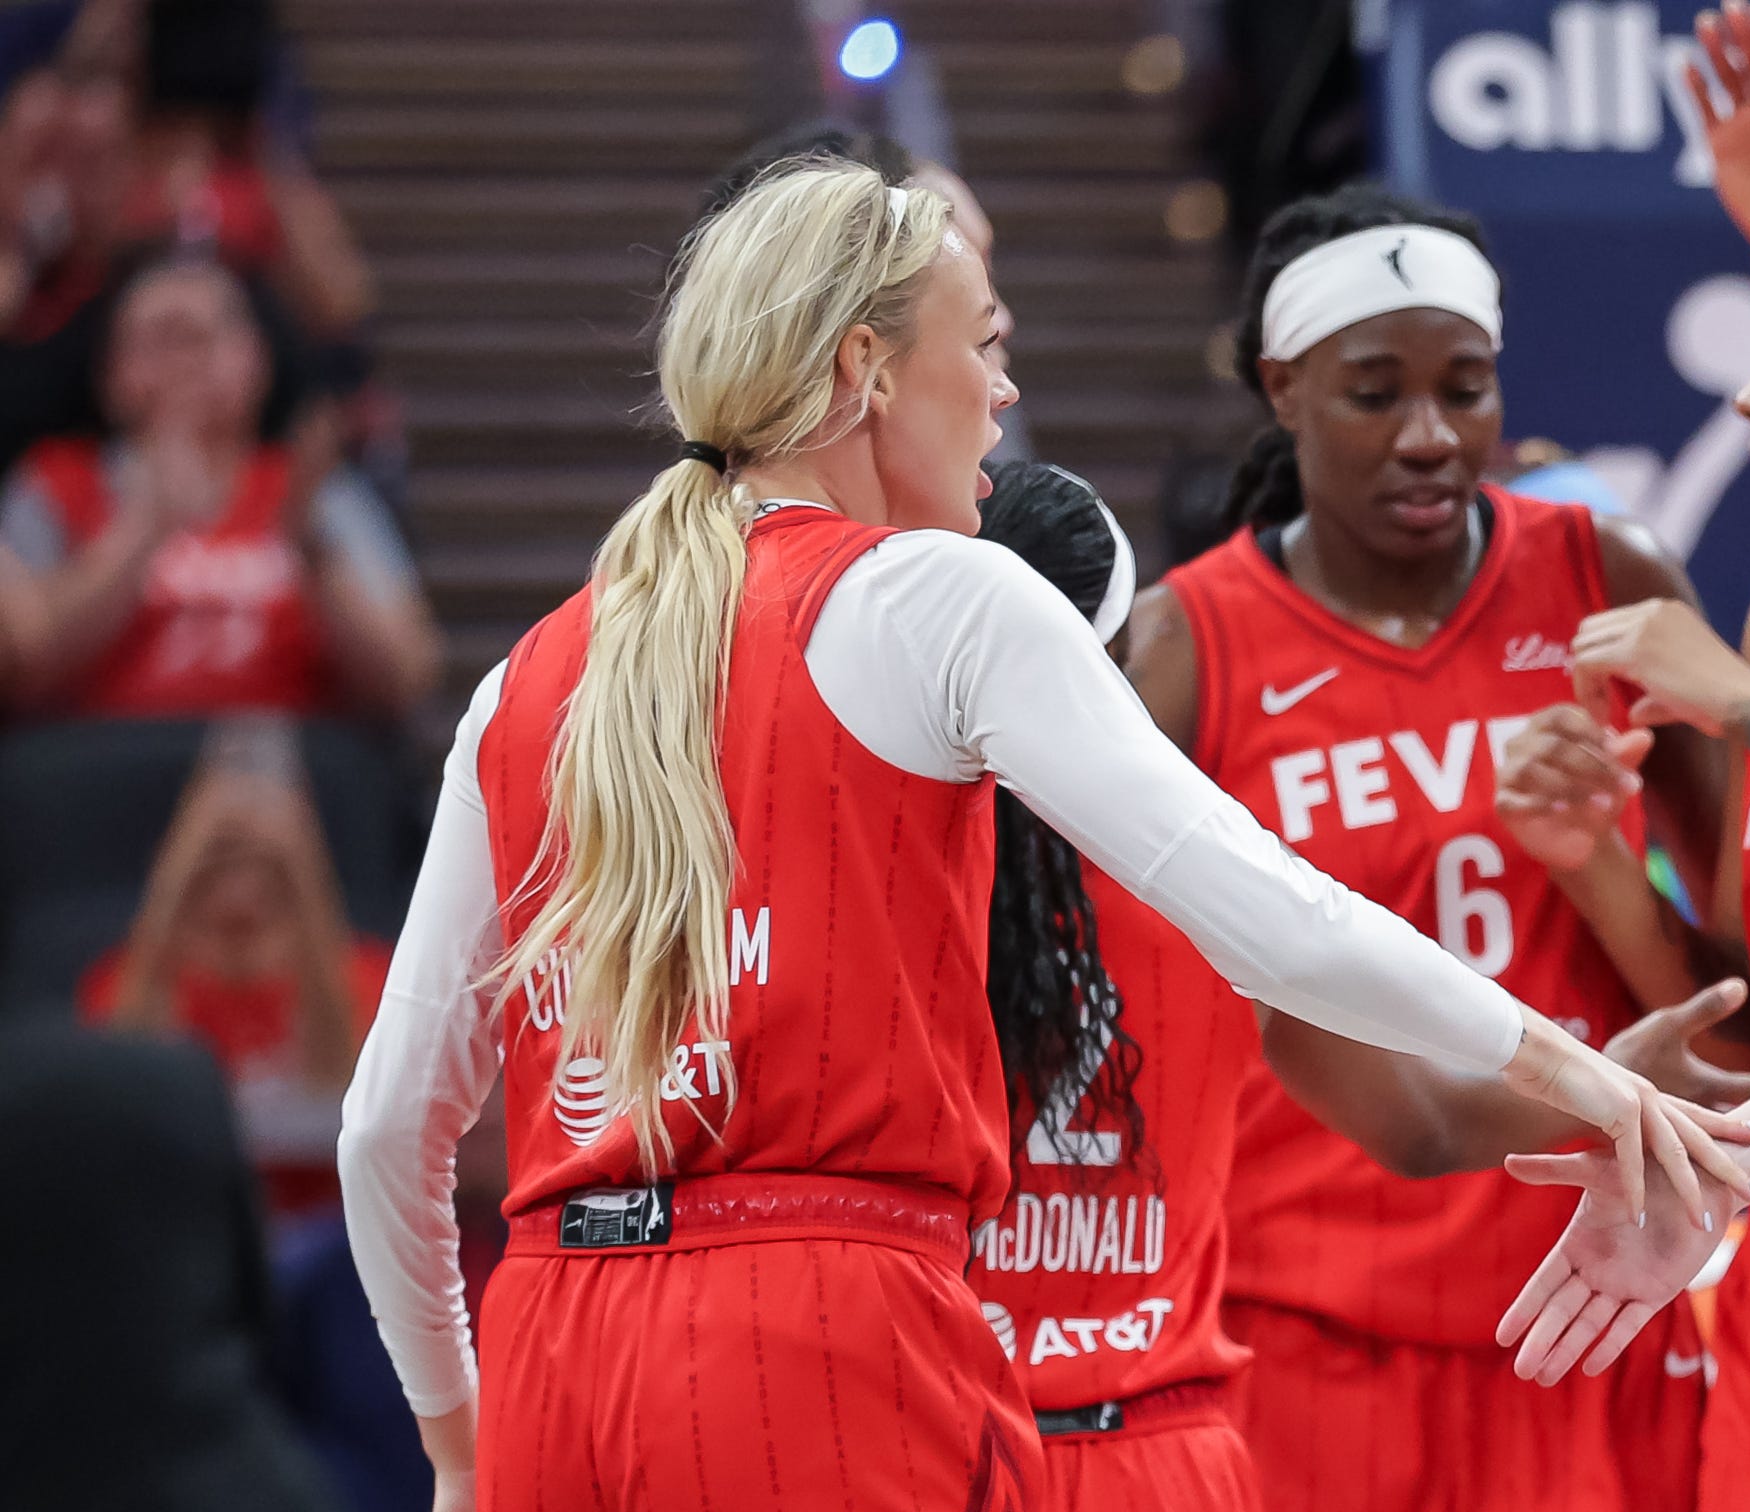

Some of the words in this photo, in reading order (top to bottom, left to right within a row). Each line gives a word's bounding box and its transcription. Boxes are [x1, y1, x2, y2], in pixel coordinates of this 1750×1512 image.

[1271, 718, 1532, 843] FEV
[1435, 833, 1514, 977] 6
[1029, 1297, 1175, 1366] AT&T
